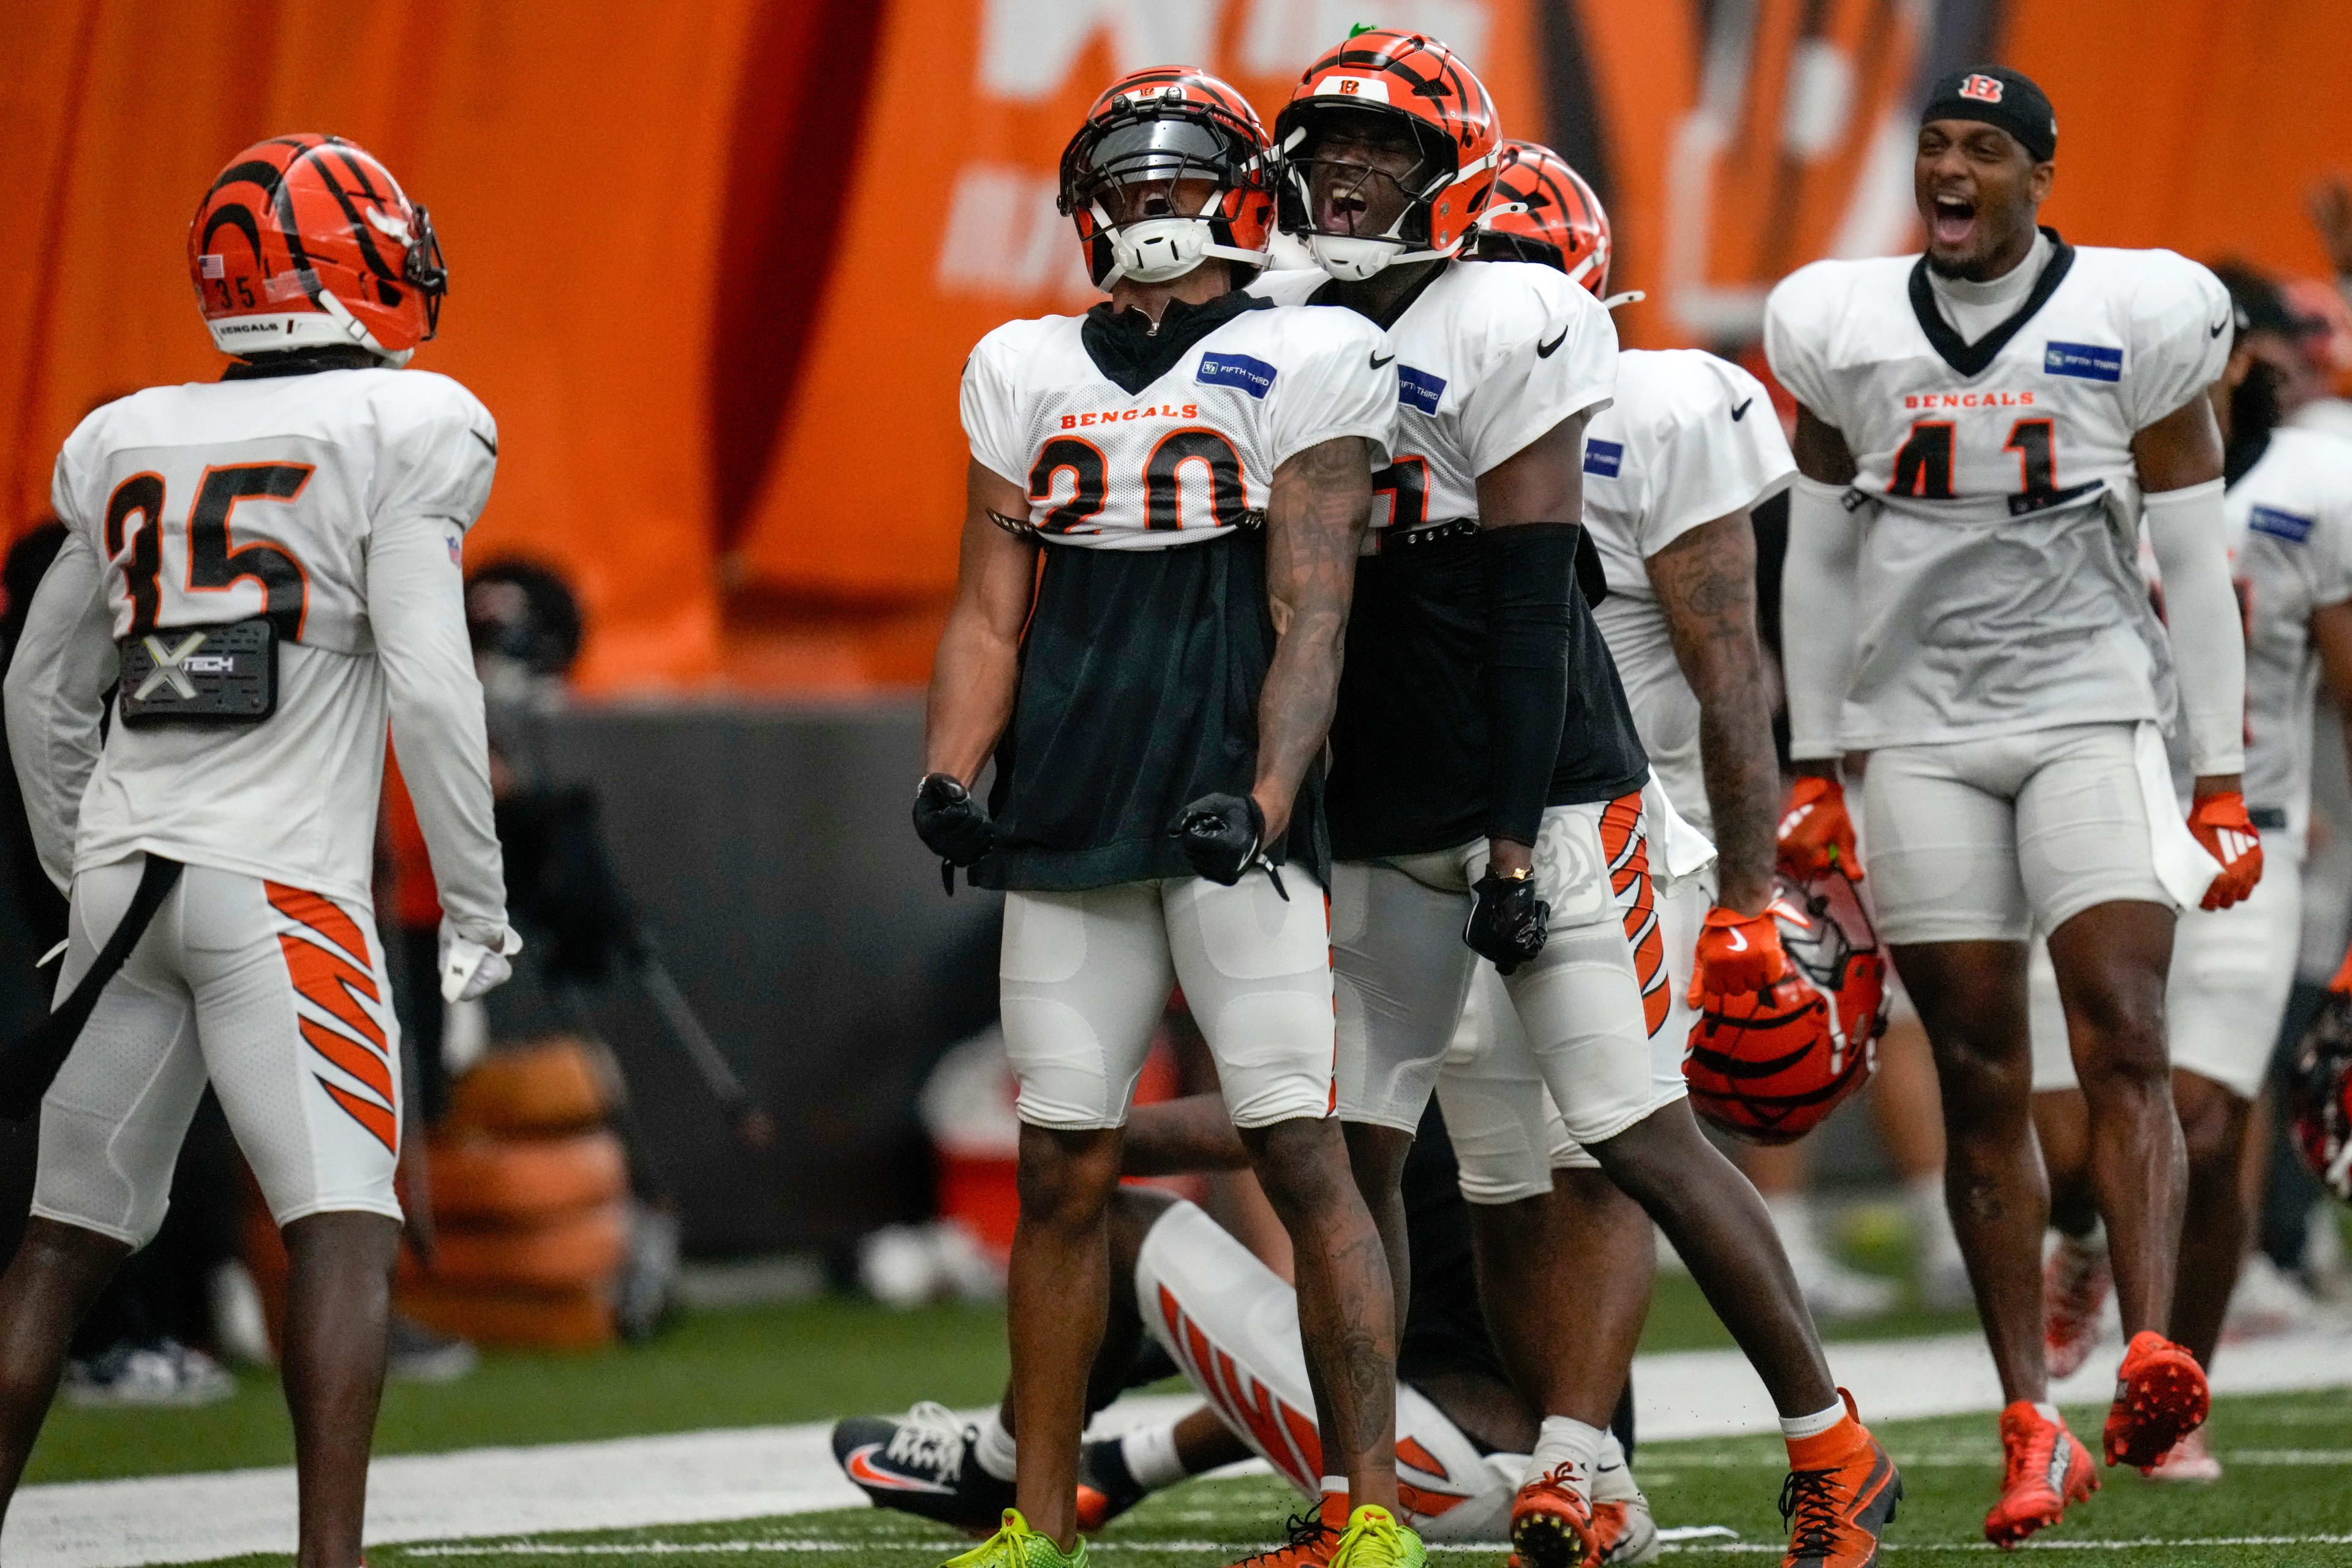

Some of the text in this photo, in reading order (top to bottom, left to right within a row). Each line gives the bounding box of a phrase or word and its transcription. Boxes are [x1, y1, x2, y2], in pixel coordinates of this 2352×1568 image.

[216, 276, 256, 309] 35
[1220, 366, 1247, 376] FIFTH
[1247, 372, 1269, 386] THIRD
[1417, 386, 1439, 400] THIRD
[1905, 391, 2034, 409] BENGALS
[1061, 404, 1198, 429] BENGALS
[1885, 418, 2059, 499] 41
[1028, 426, 1250, 535] 20
[105, 461, 317, 643] 35
